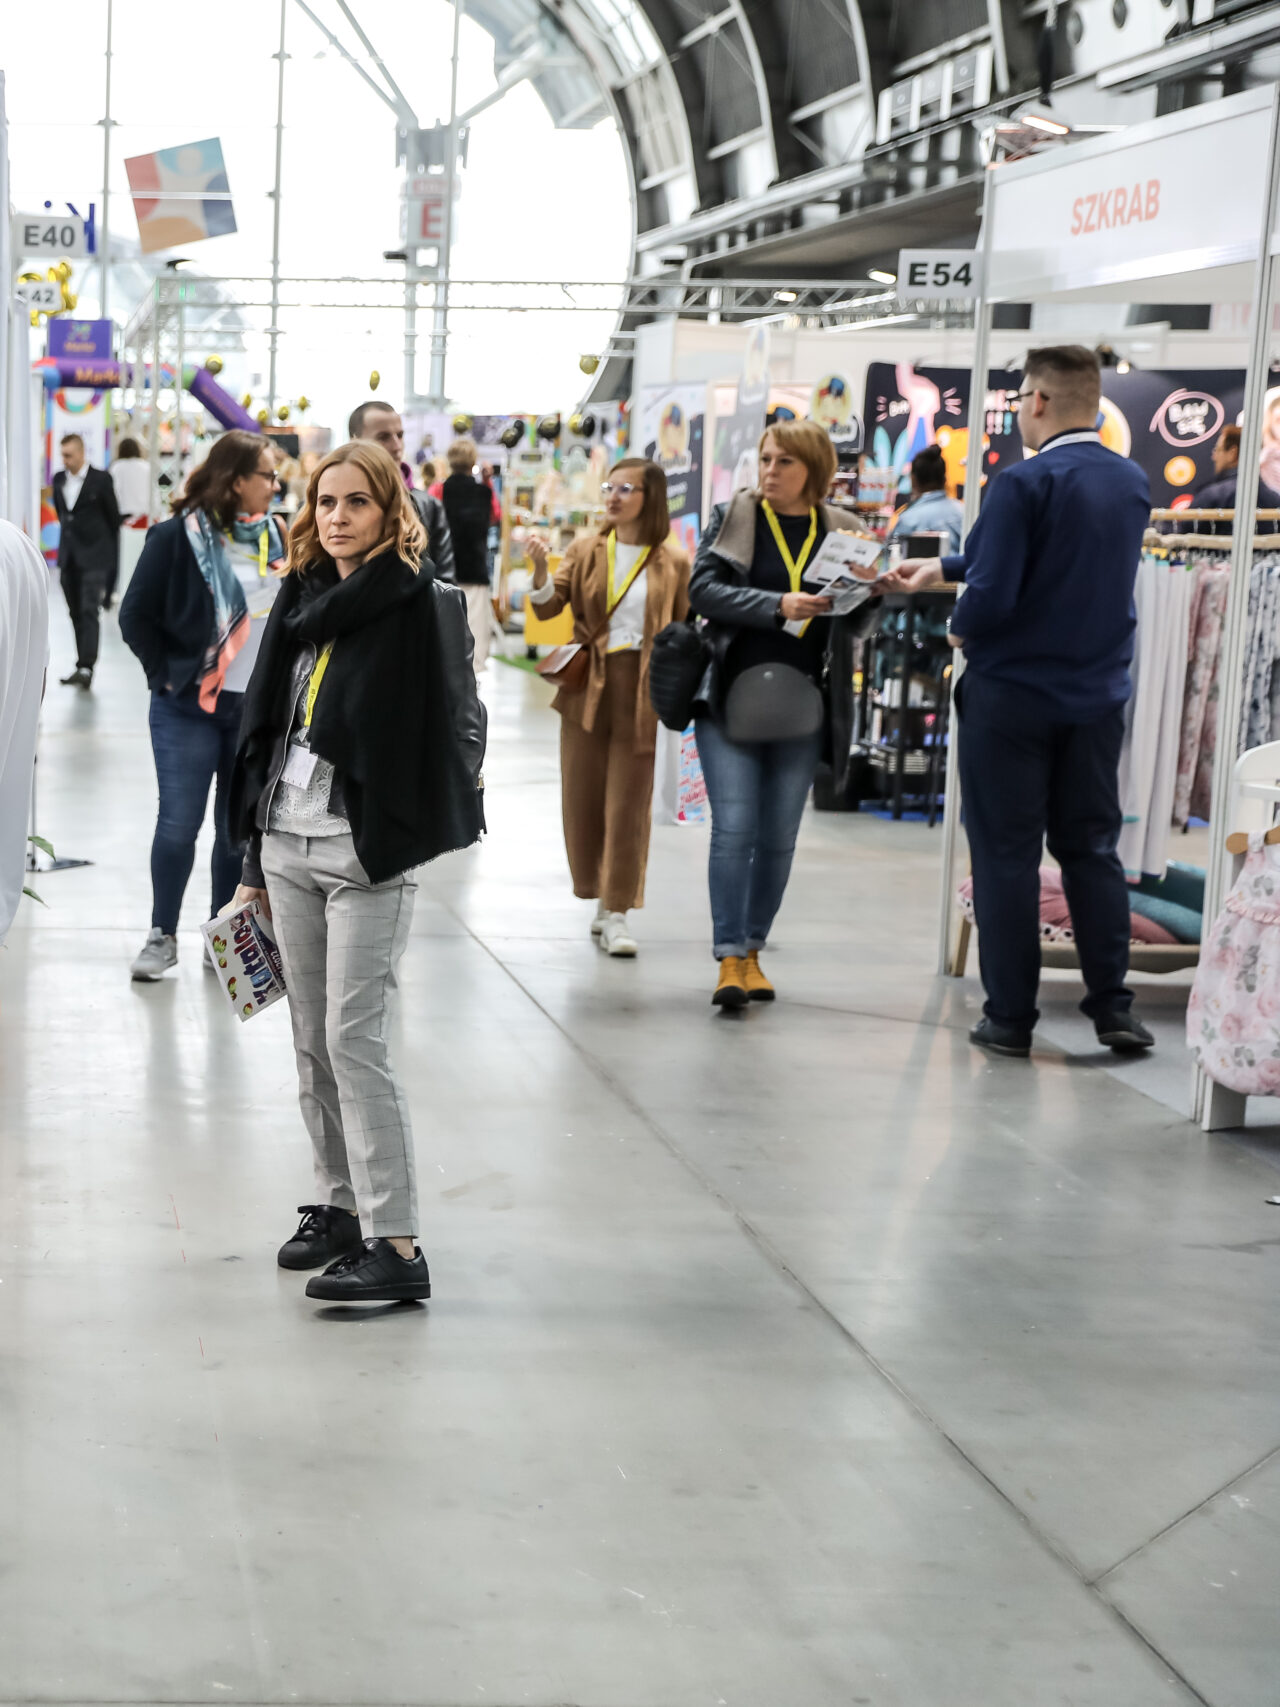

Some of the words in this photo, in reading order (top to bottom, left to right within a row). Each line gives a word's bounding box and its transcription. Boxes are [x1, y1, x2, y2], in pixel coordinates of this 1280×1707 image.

[1071, 179, 1160, 236] SZKRAB
[23, 225, 75, 247] E40
[908, 262, 973, 287] E54
